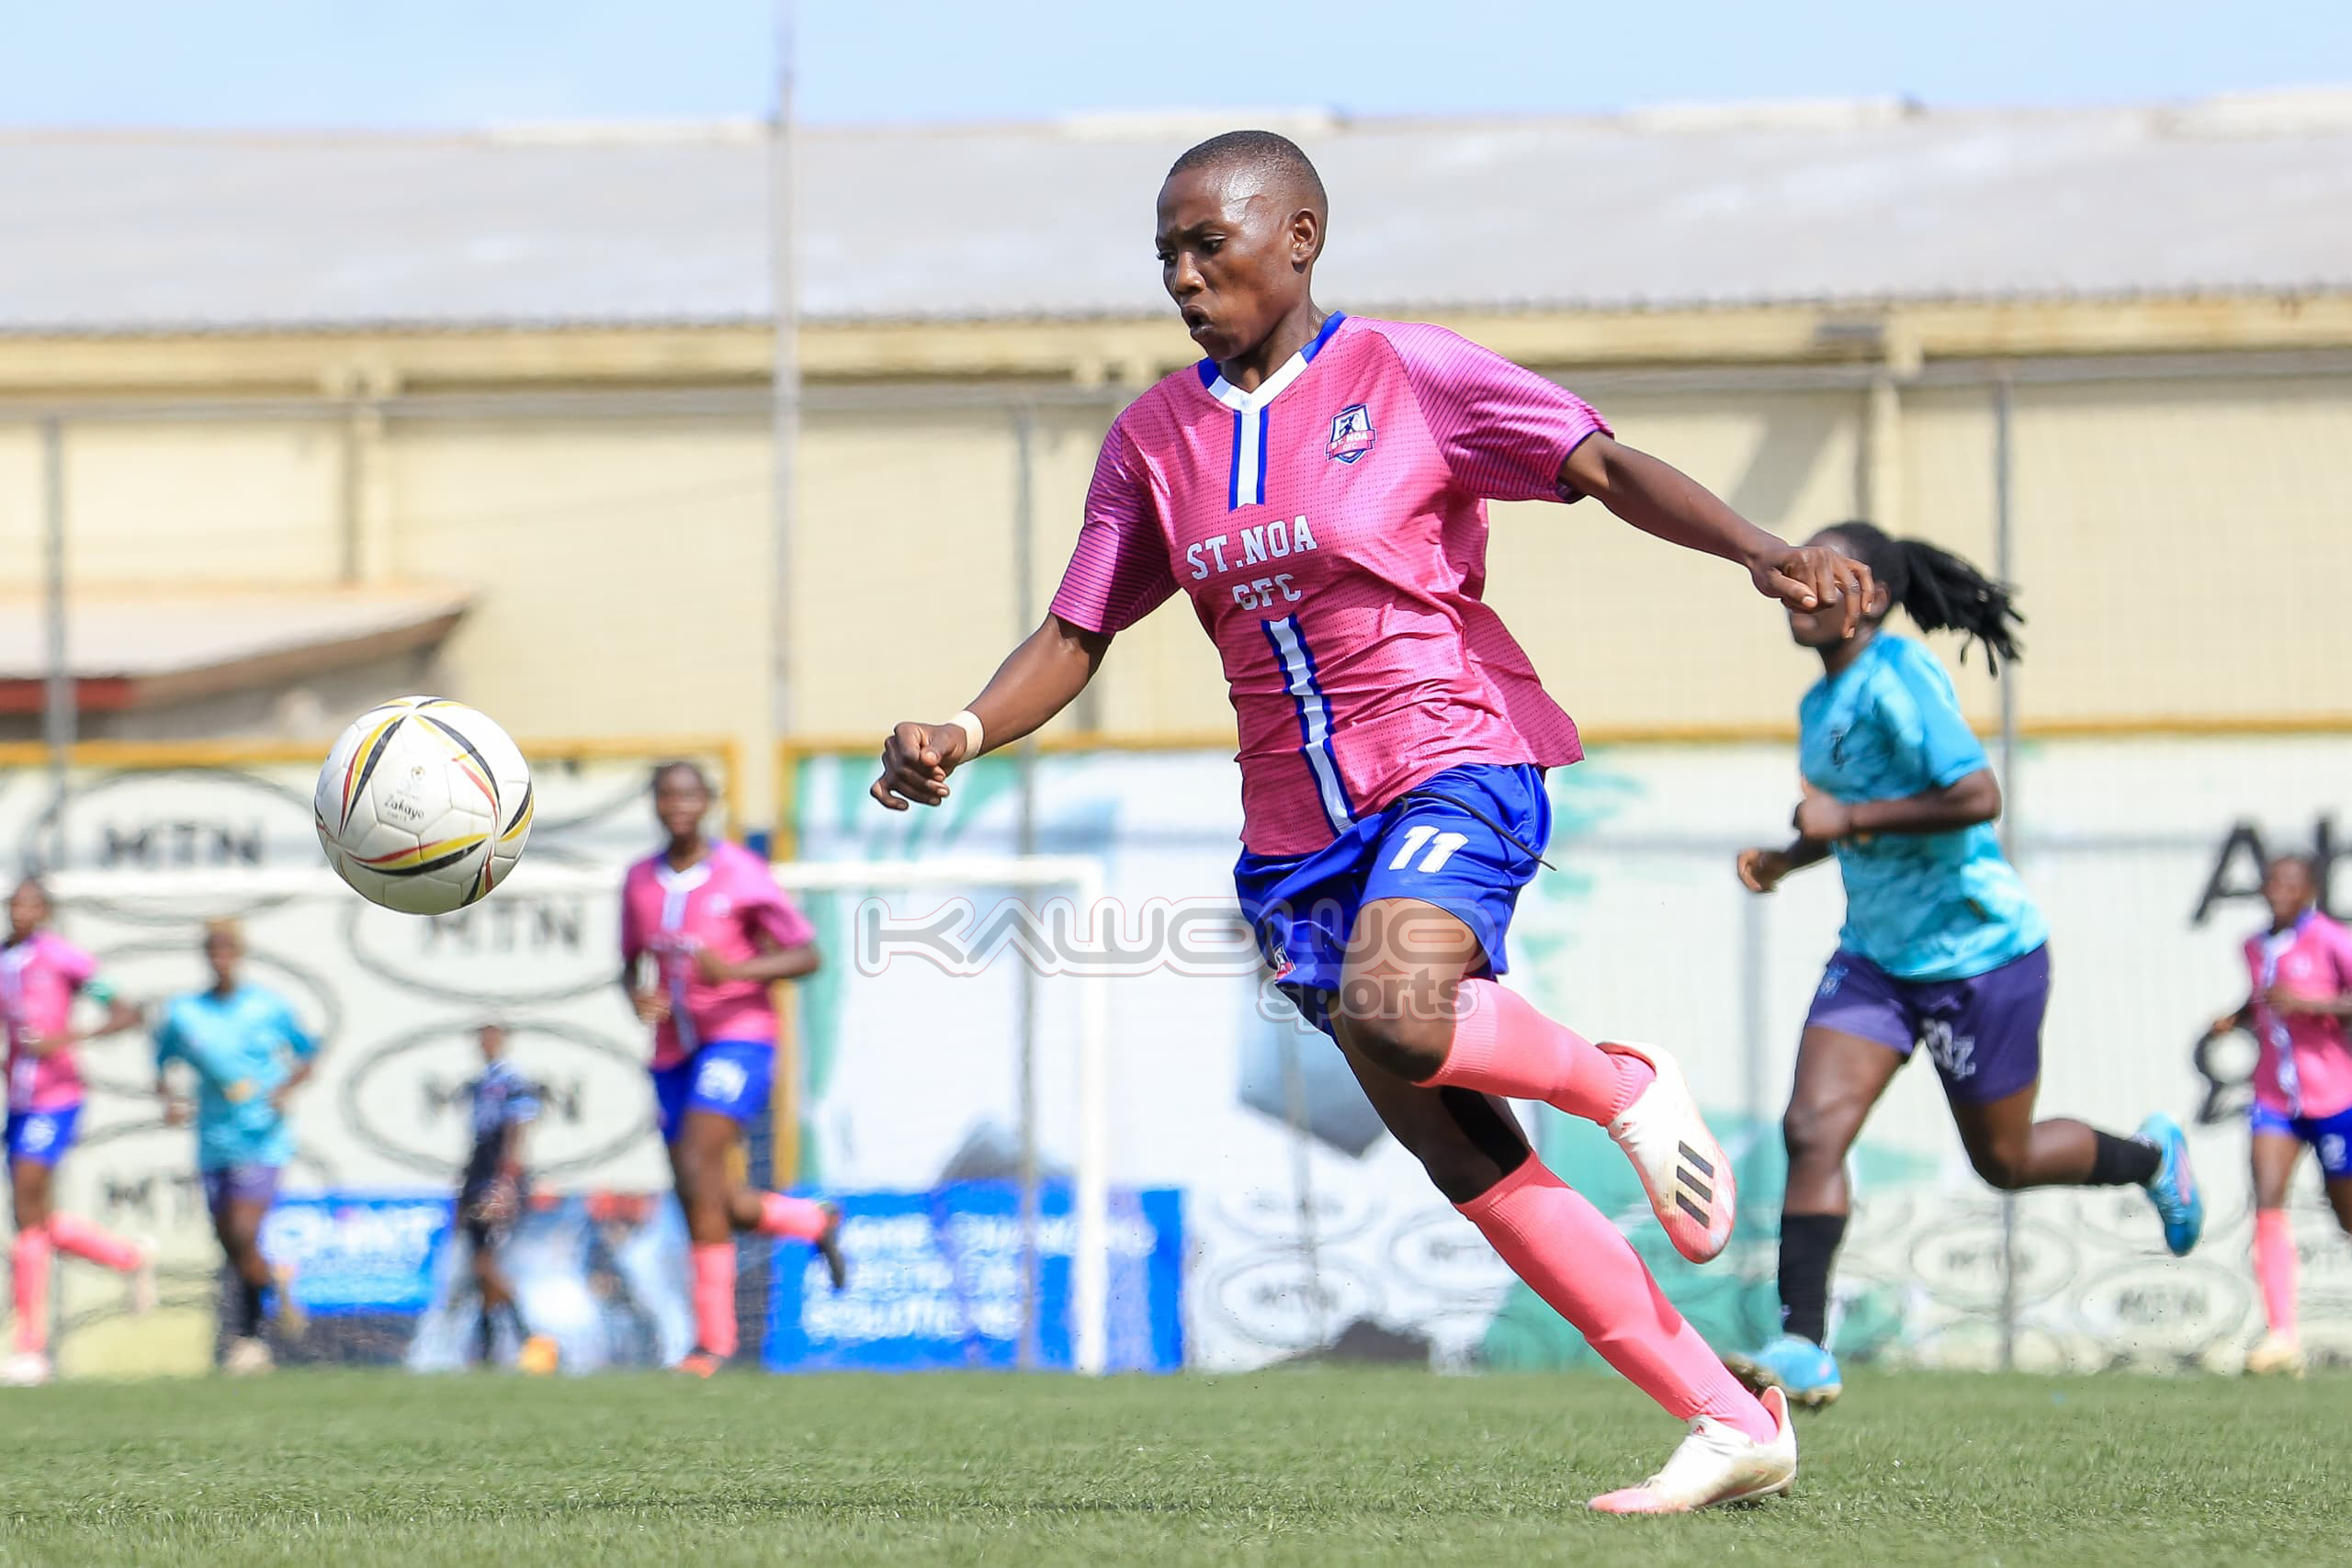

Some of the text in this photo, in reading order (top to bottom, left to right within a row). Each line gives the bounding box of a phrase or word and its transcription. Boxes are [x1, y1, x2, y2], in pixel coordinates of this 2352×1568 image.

[1232, 573, 1302, 611] GFC
[384, 794, 425, 820] Zakayo
[103, 823, 265, 868] MTN
[1388, 825, 1469, 874] 11
[421, 1068, 585, 1124] MN
